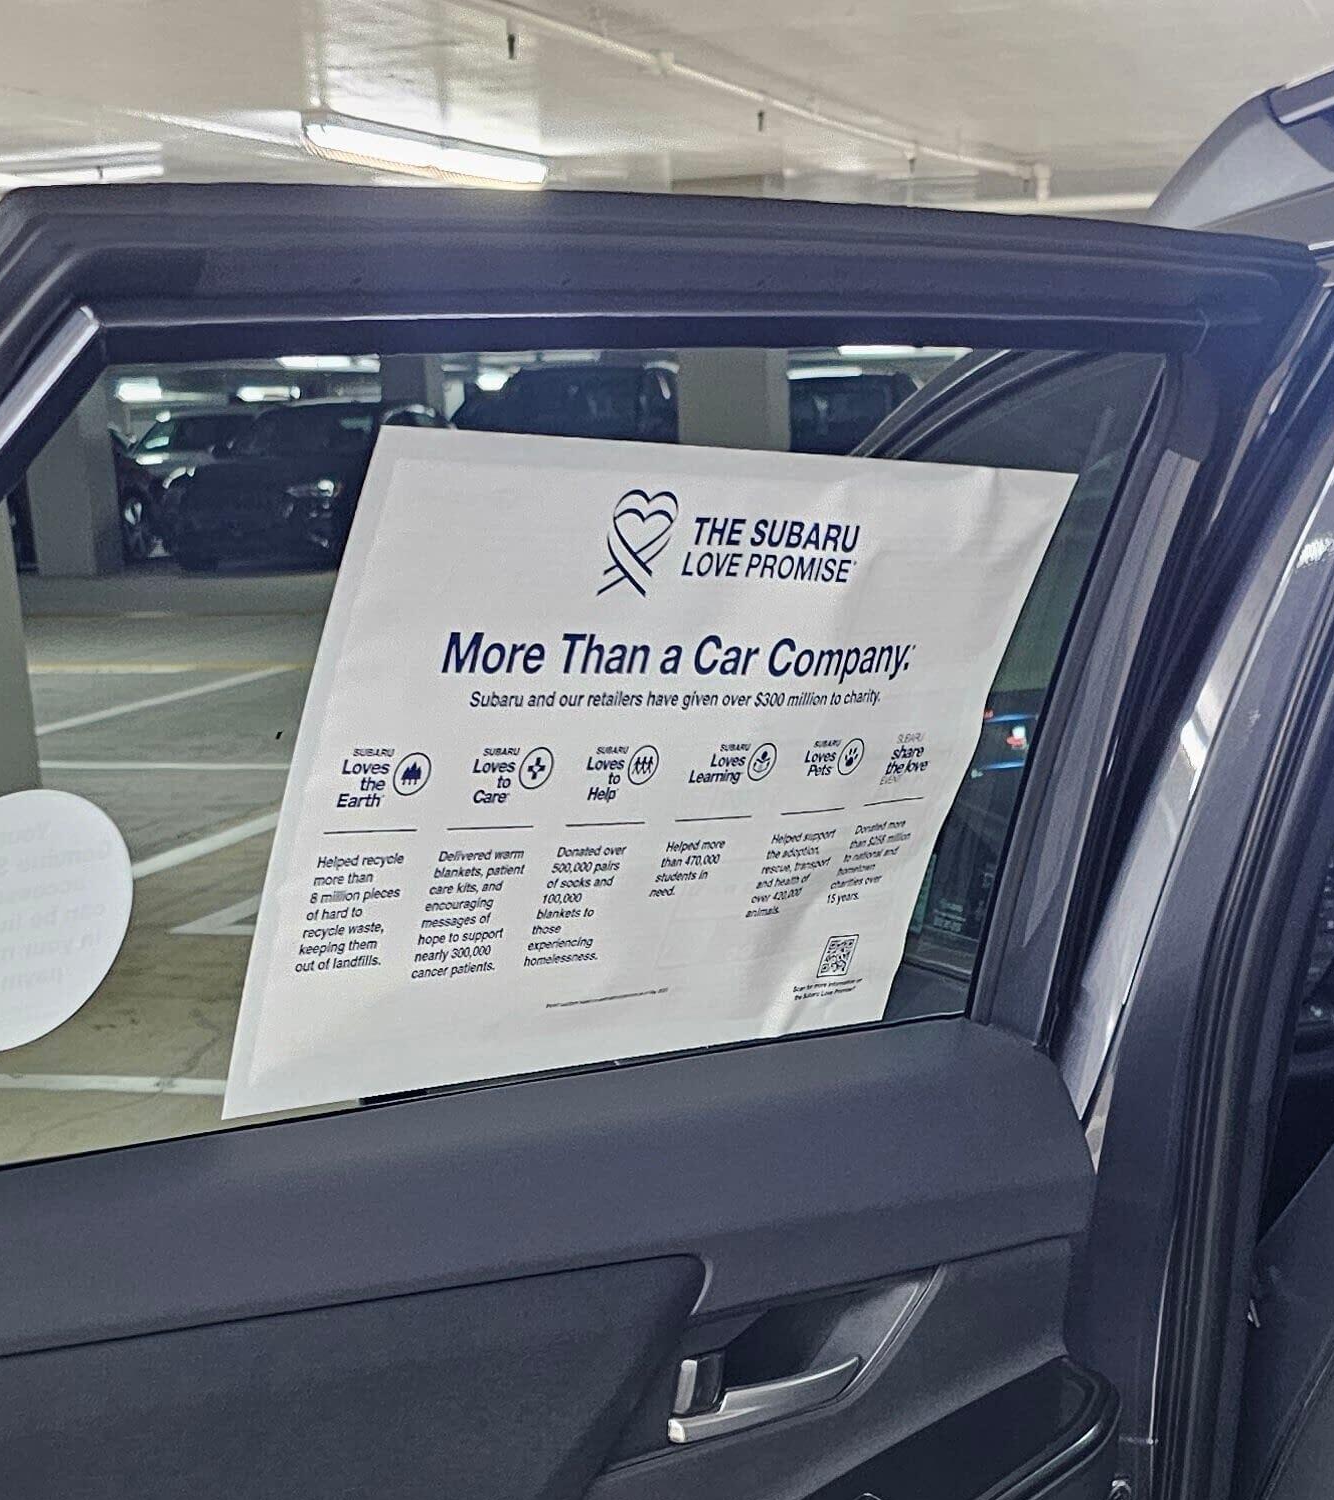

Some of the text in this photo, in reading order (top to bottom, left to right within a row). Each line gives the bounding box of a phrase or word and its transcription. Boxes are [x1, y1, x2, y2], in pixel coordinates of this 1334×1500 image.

[694, 517, 860, 553] THE SUBARU
[681, 552, 854, 583] LOVE PROMISE
[442, 632, 545, 674] More
[562, 633, 650, 674] Than
[660, 645, 682, 674] a
[693, 635, 759, 676] Car
[470, 689, 881, 710] Subaru and our retailers have given over $300 million to charity.
[596, 746, 629, 755] SUBARU
[720, 743, 752, 752] SUBARU
[815, 740, 842, 748] SUBARU
[353, 749, 395, 758] SUBARU
[483, 748, 520, 756] SUBARU
[804, 750, 837, 763] Loves
[891, 745, 924, 760] share
[342, 760, 390, 775] Loves
[472, 759, 515, 774] Loves
[586, 757, 625, 772] Loves
[710, 753, 746, 768] Loves
[885, 759, 929, 775] the love
[689, 771, 741, 785] Learning
[807, 764, 832, 777] Pets
[360, 776, 385, 791] the
[497, 776, 511, 789] to
[608, 772, 621, 785] to
[879, 775, 901, 786] EVENT
[337, 794, 382, 809] Earth
[473, 790, 508, 805] Care
[587, 787, 617, 803] Help
[855, 820, 906, 835] Donated more
[771, 829, 837, 845] Helped support
[849, 839, 867, 850] than
[887, 832, 911, 844] million
[557, 847, 627, 858] Donated over
[666, 839, 726, 853] Helped more
[317, 852, 405, 870] Helped recycle
[438, 849, 524, 862] Delivered warm
[661, 853, 721, 868] than 470,000
[767, 850, 781, 860] the
[843, 846, 900, 863] to national and
[434, 864, 525, 879] blankets, patient
[551, 862, 620, 874] 500,000 pairs
[761, 856, 832, 875] rescue, transport
[314, 873, 373, 886] more than
[547, 876, 615, 889] of socks and
[655, 869, 709, 883] students in
[756, 873, 811, 890] and health of
[830, 875, 883, 890] charities over
[429, 880, 504, 896] care kits, and
[649, 887, 675, 897] need.
[310, 888, 401, 904] 8 million pieces
[542, 892, 582, 905] 100,000
[751, 894, 771, 904] over
[827, 894, 837, 904] 15
[425, 897, 494, 912] encouraging
[306, 907, 363, 921] of hard to
[421, 912, 492, 929] messages of
[537, 907, 595, 920] blankets to
[303, 922, 384, 940] recycle waste,
[532, 924, 562, 935] those
[418, 928, 504, 947] hope to support
[528, 937, 594, 952] experiencing
[298, 938, 377, 957] keeping them
[414, 945, 492, 963] nearly 300,000
[295, 955, 381, 972] out of landfills.
[524, 952, 599, 967] homelessness.
[411, 961, 495, 979] cancer patients.
